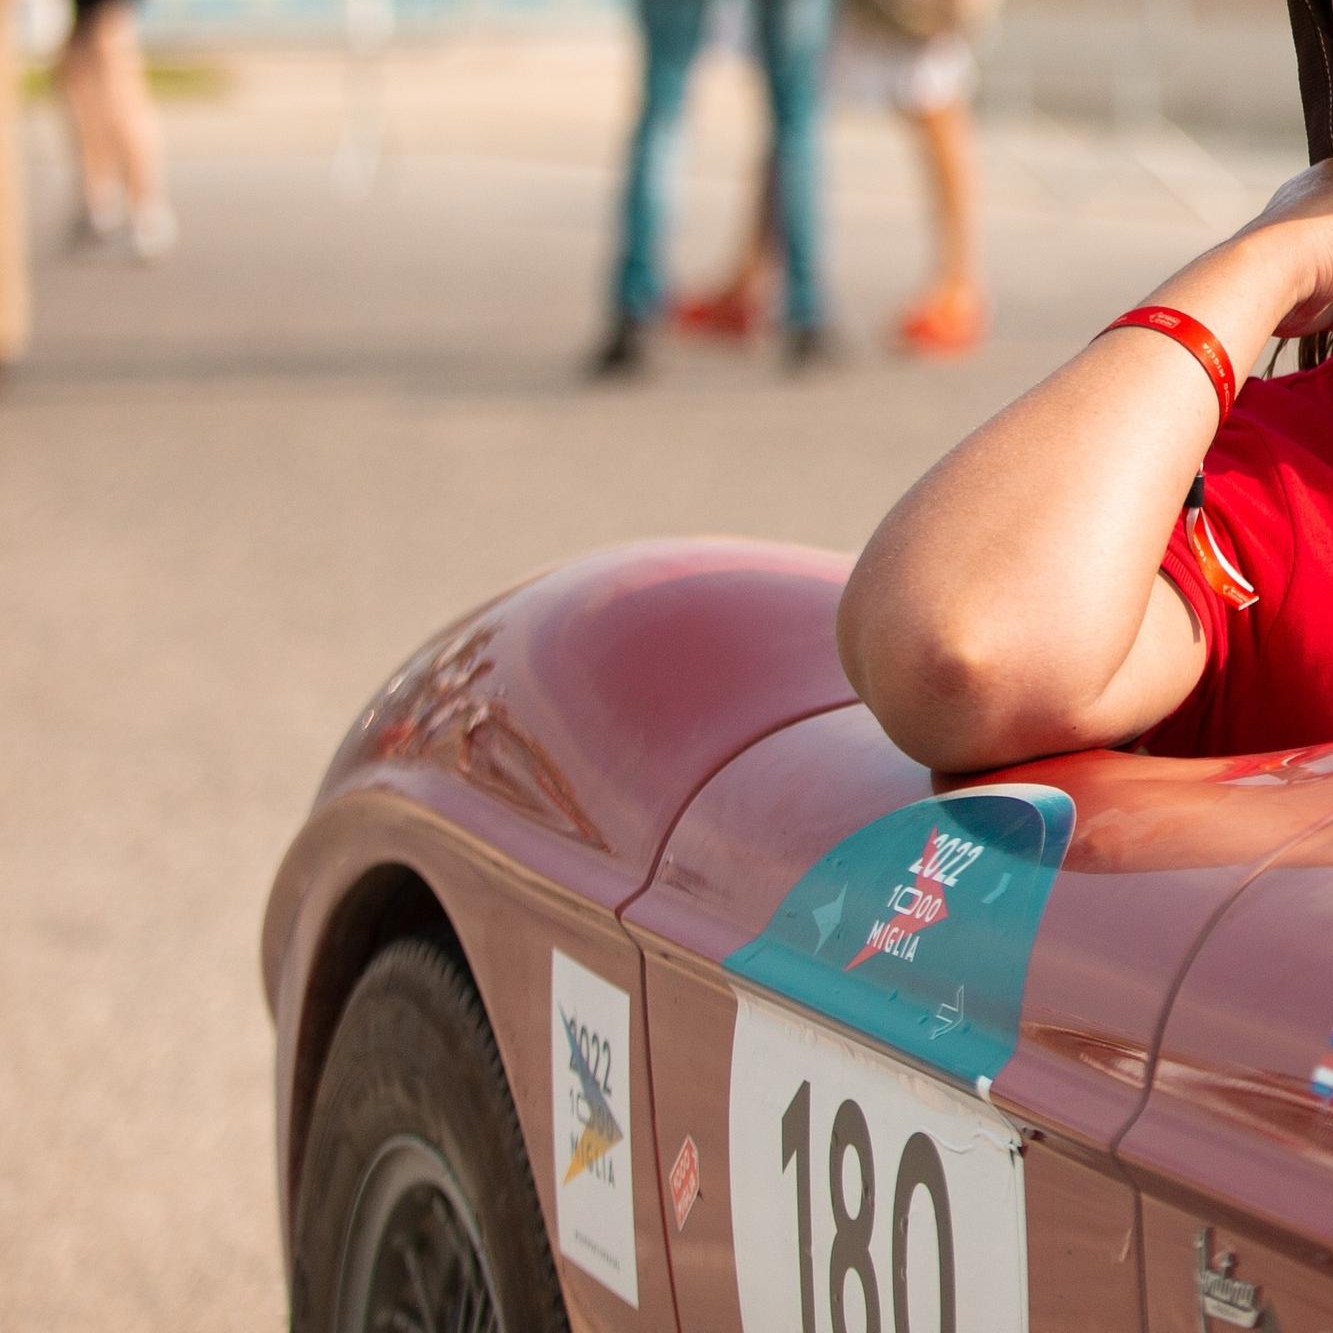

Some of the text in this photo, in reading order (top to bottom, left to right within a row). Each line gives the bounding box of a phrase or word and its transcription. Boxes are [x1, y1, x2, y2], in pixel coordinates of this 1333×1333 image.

[908, 833, 985, 888] 2022
[887, 884, 942, 923] 1000
[866, 919, 920, 963] MIGLIA
[568, 1018, 612, 1097] 2022
[569, 1130, 615, 1189] MIGLIA
[781, 1079, 956, 1333] 180
